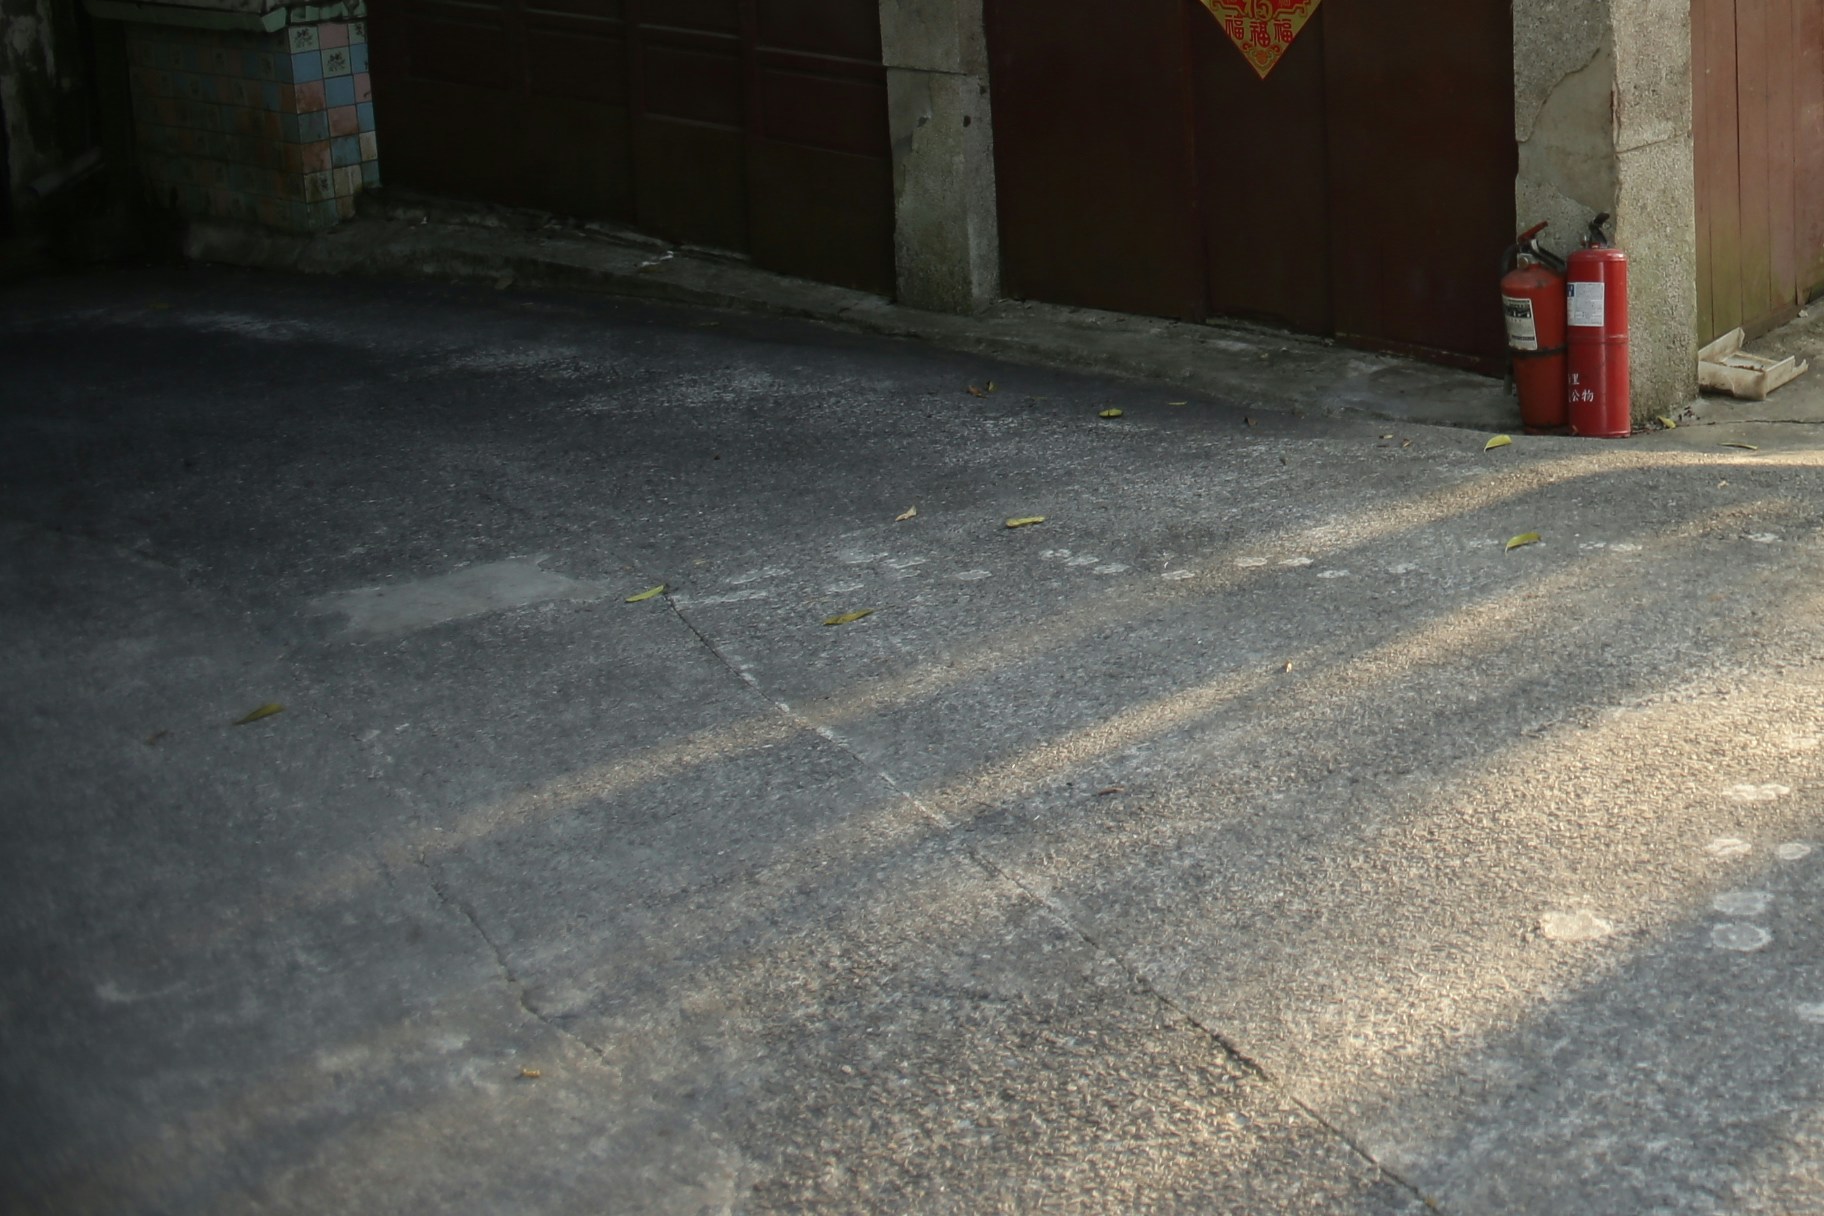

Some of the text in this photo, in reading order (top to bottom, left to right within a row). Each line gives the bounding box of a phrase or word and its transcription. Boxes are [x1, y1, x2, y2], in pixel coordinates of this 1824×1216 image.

[1225, 15, 1244, 39] 福
[1250, 21, 1270, 47] 福
[1274, 19, 1293, 43] 福
[1568, 373, 1580, 385] 里
[1568, 389, 1594, 403] 公物
